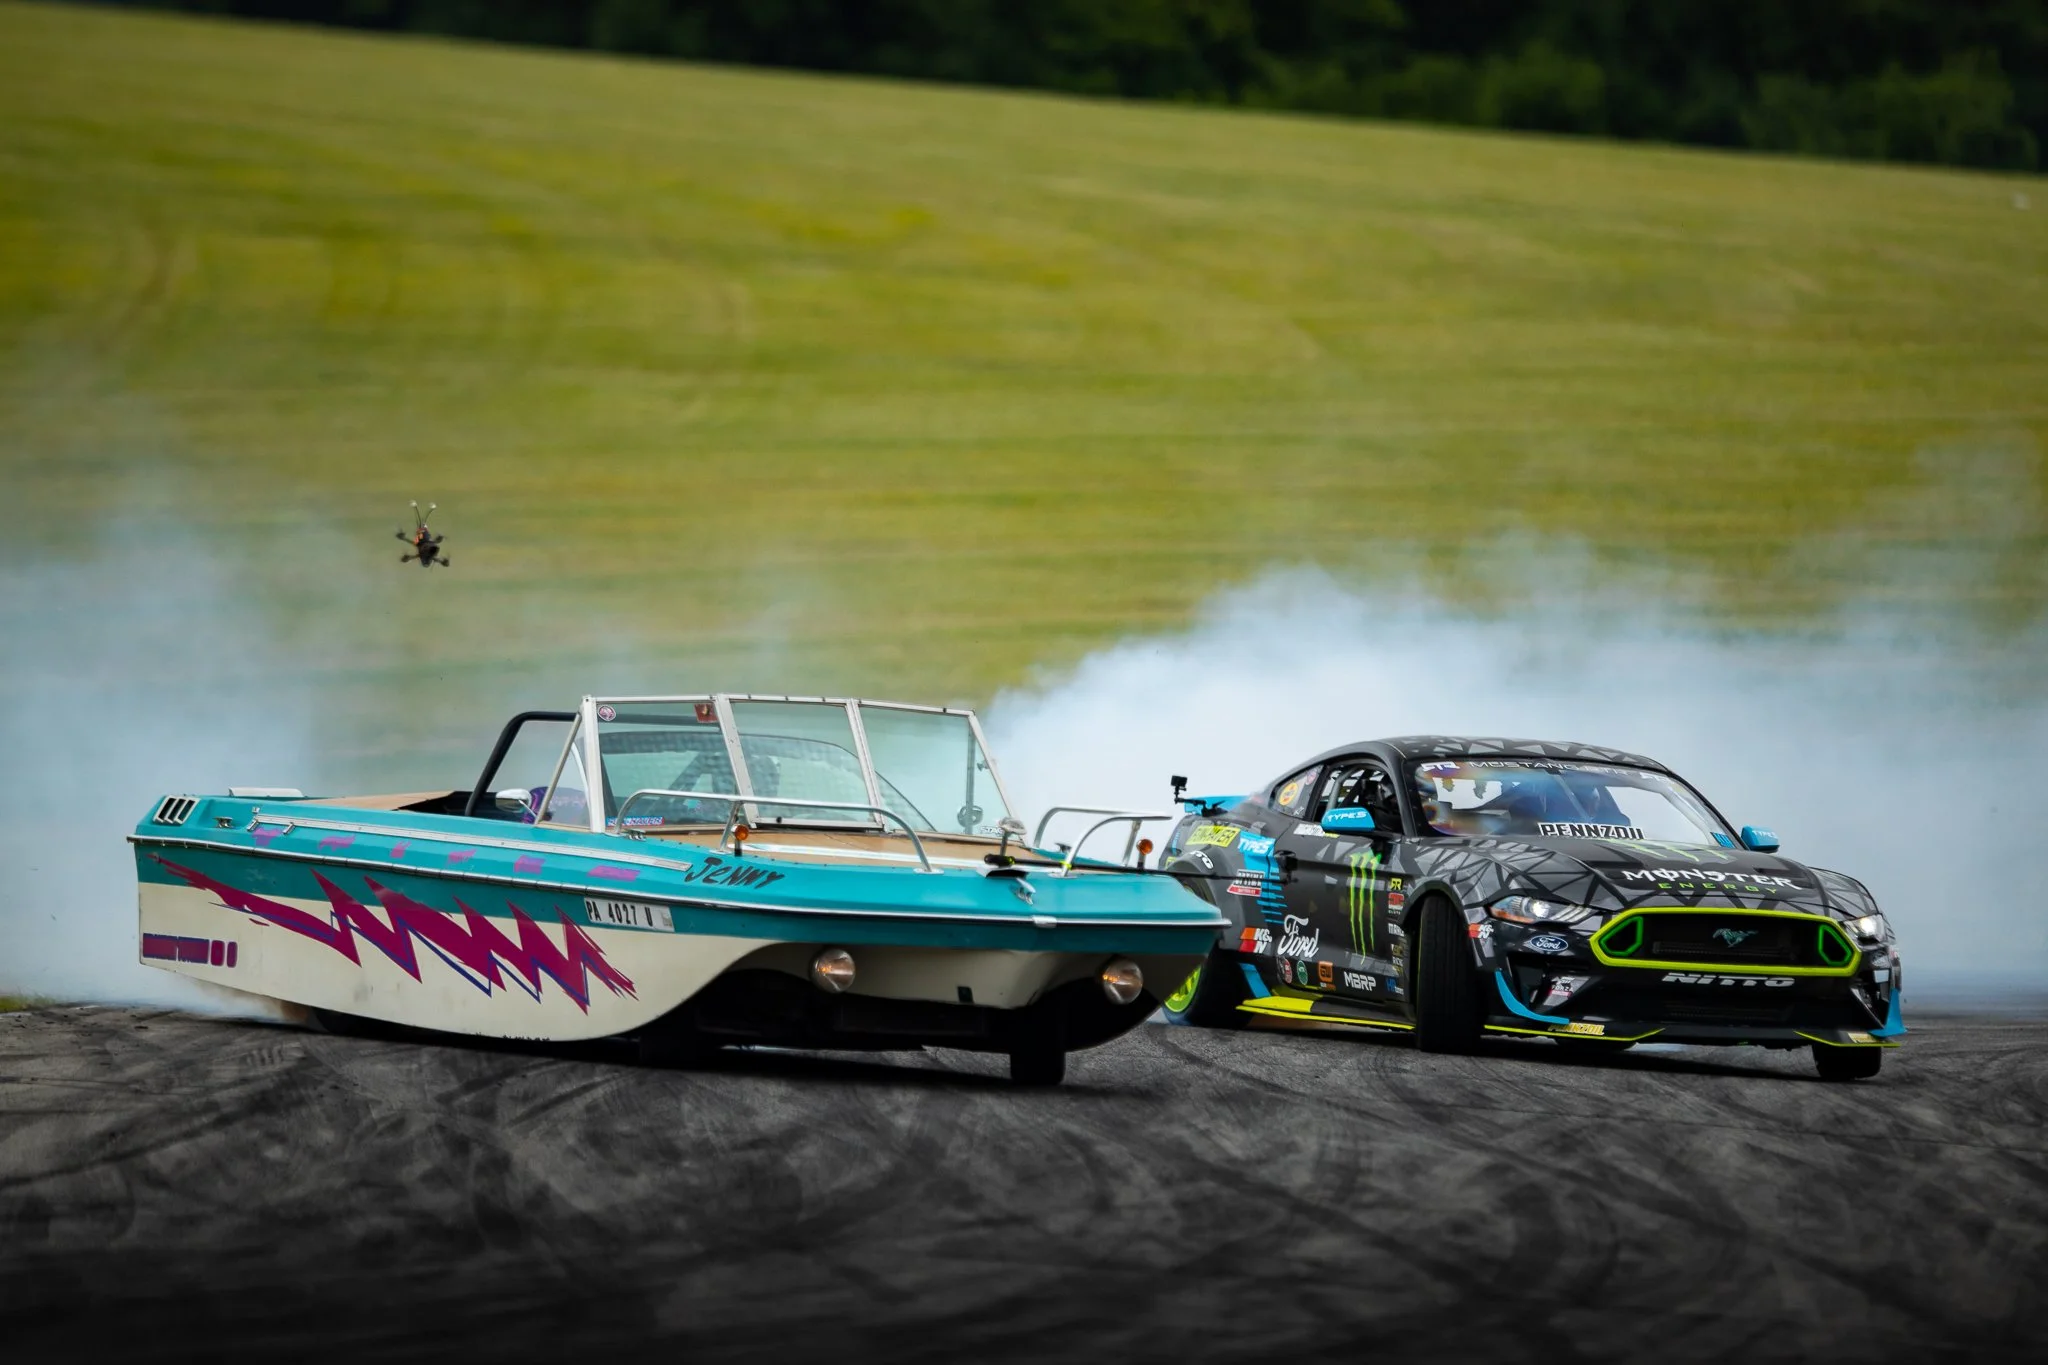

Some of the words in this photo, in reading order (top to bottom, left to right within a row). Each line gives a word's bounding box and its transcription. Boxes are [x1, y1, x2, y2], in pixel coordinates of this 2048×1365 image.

[1621, 868, 1803, 890] MONSTER
[1658, 882, 1777, 894] ENERGY
[586, 901, 602, 921] PA
[608, 903, 638, 926] 4027
[645, 907, 653, 927] U
[1277, 914, 1320, 958] Ford
[1536, 938, 1561, 950] Ford
[1344, 971, 1377, 992] MBRP
[1662, 972, 1795, 987] NITTO
